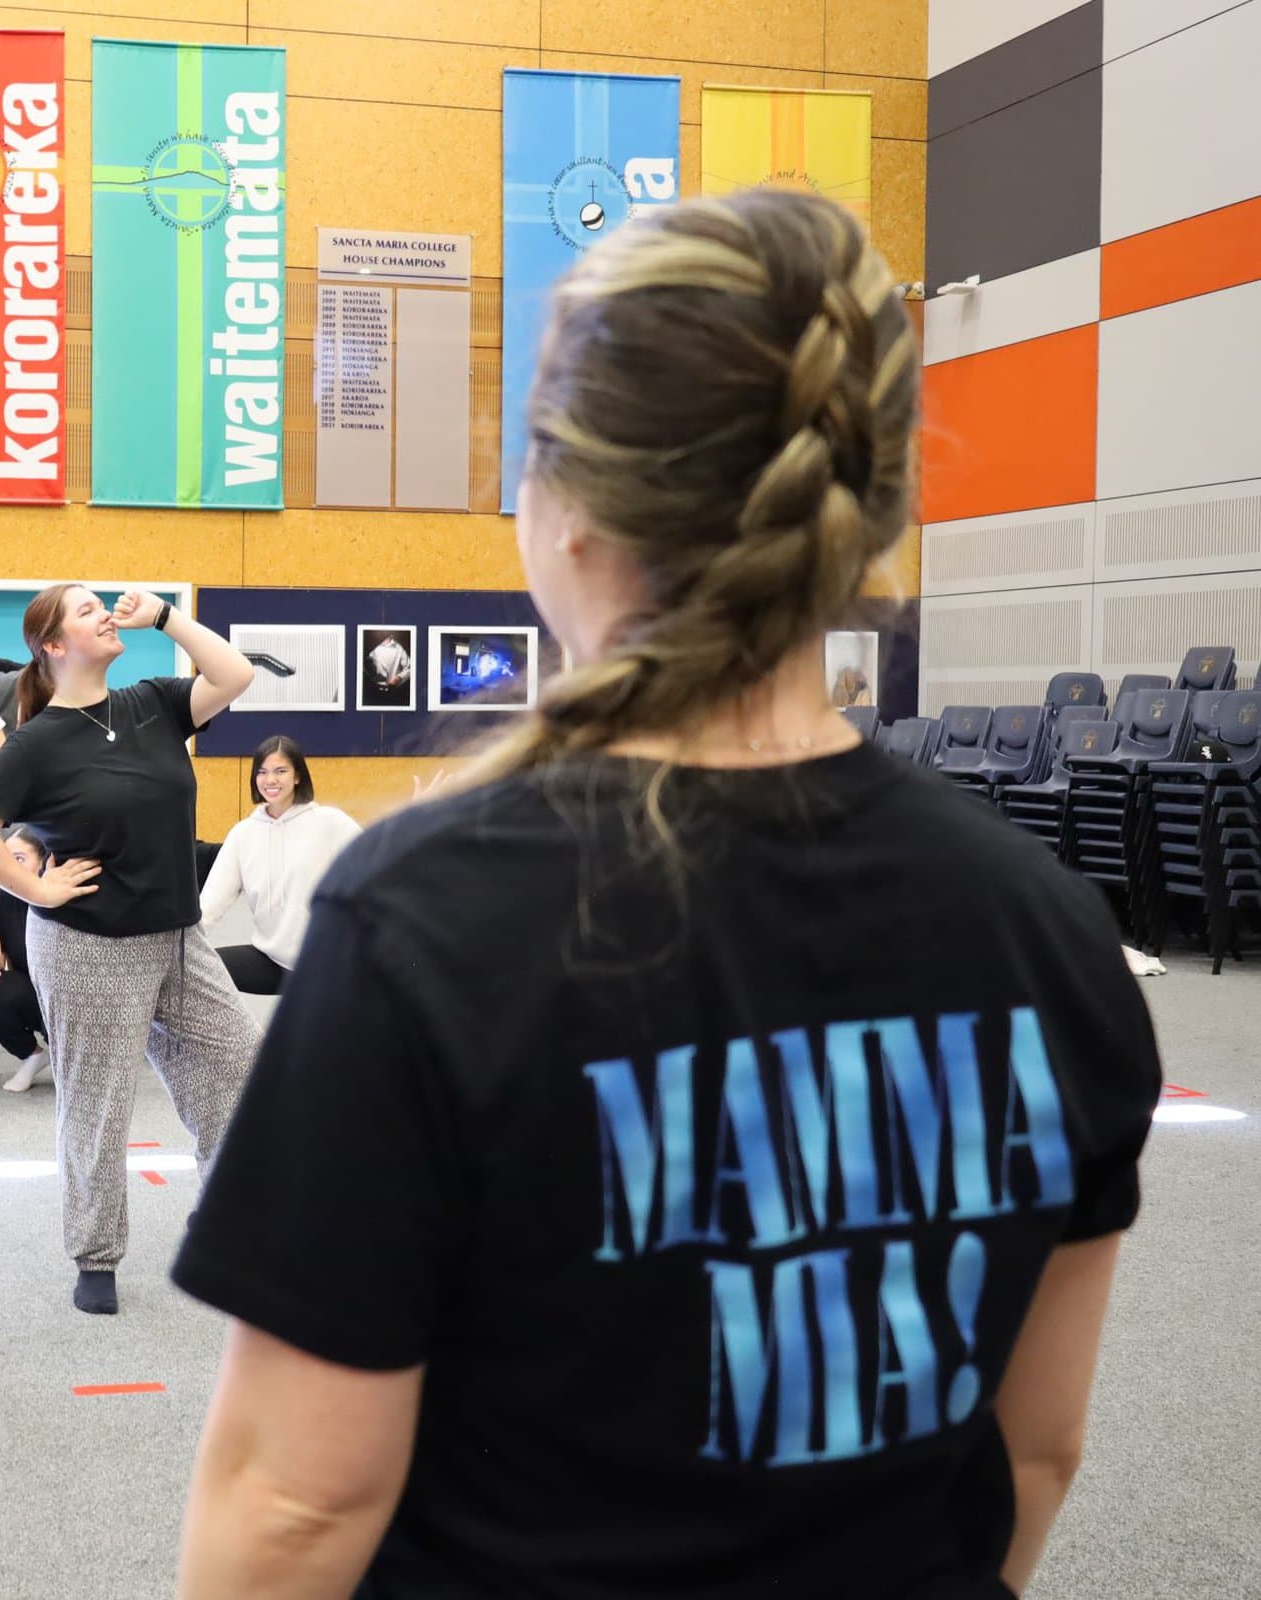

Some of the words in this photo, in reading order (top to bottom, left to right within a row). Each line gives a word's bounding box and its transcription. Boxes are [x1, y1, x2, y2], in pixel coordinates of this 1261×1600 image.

[333, 238, 372, 248] SANCTA
[375, 240, 408, 250] MARIA
[411, 242, 457, 253] COLLEGE
[343, 255, 379, 265] HOUSE
[382, 257, 446, 269] CHAMPIONS
[209, 92, 279, 487] waitemata
[343, 355, 388, 363] KORORAREKA
[342, 387, 387, 395] KORORAREKA
[341, 423, 385, 431] KORORAREKA
[583, 1007, 1074, 1261] MAMMA
[698, 1231, 986, 1469] MIA!
